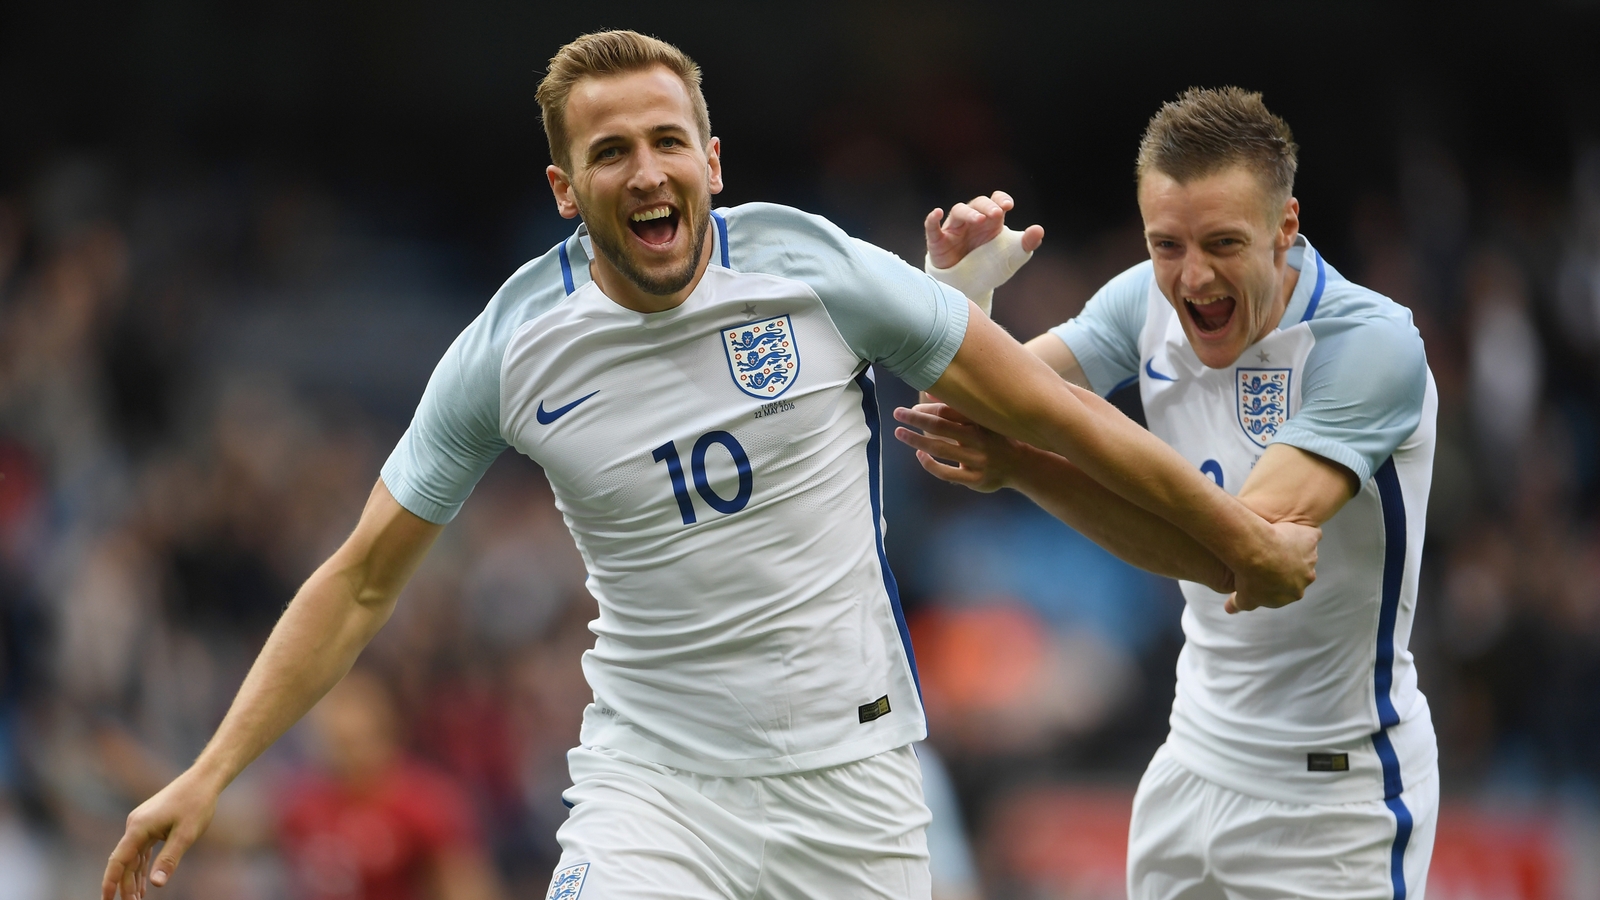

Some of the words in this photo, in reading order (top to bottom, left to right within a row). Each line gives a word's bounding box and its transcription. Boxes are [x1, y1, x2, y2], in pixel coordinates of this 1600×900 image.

[754, 411, 762, 419] 22
[763, 407, 778, 416] MAY
[780, 402, 795, 412] 2016
[651, 430, 753, 525] 10
